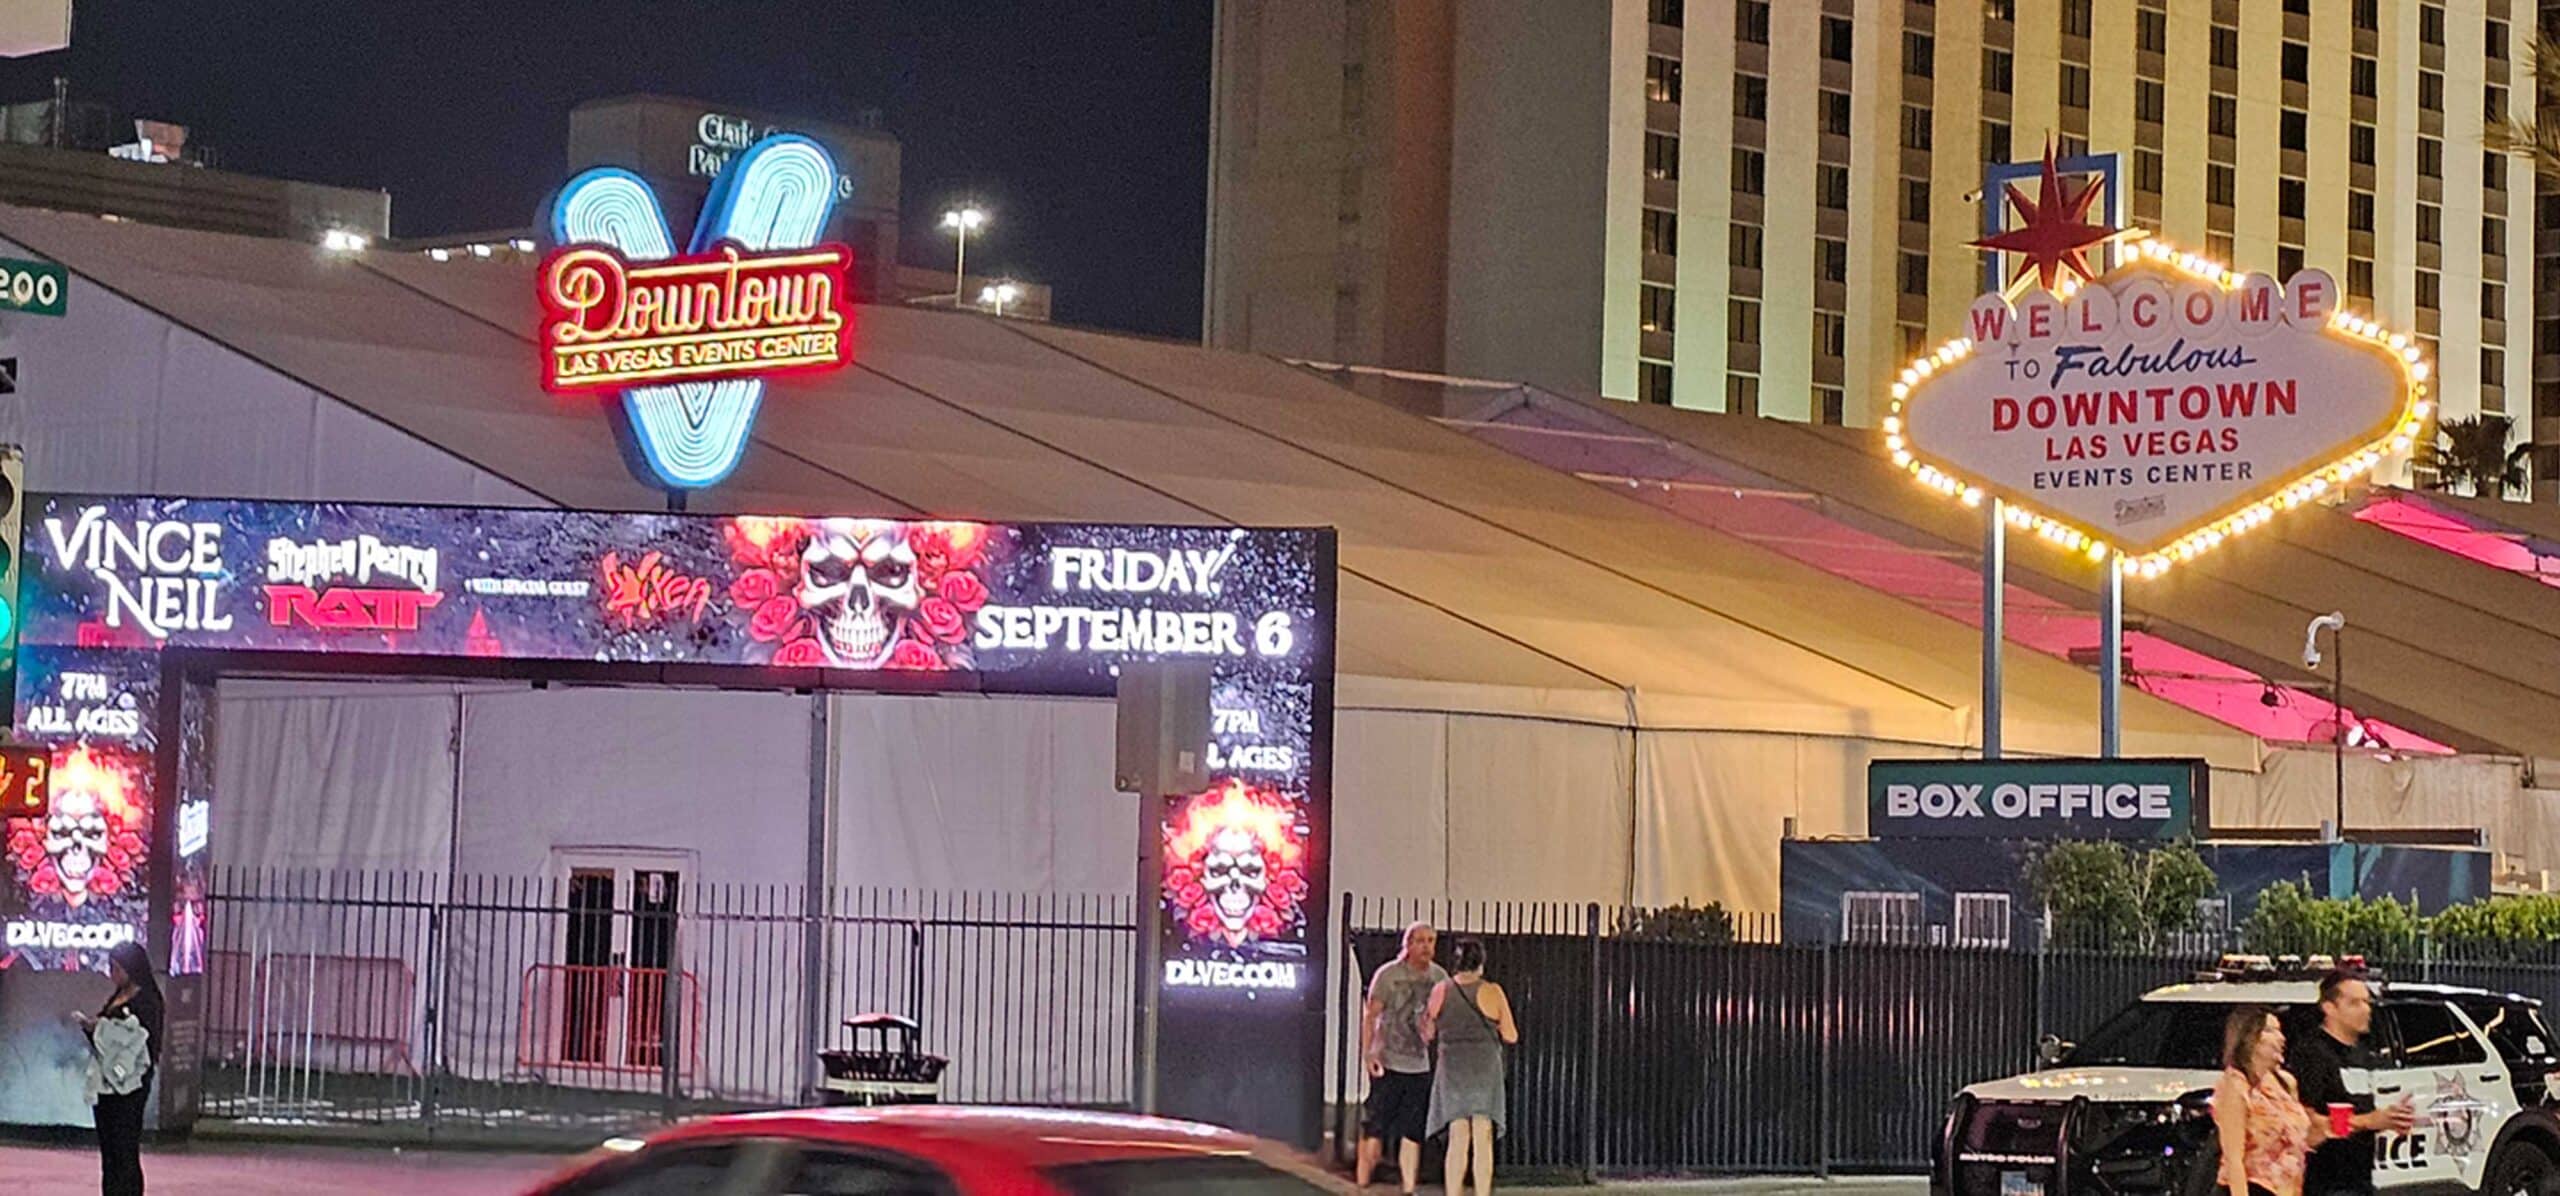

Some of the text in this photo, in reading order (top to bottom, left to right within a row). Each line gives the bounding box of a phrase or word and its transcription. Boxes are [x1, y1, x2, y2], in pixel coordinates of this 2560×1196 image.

[551, 246, 842, 343] Downtown
[1970, 282, 2323, 342] WELCOME
[557, 333, 838, 377] LAS VEGAS EVENTS CENTER
[2005, 338, 2257, 390] TO Fabulous
[1992, 379, 2297, 432] DOWNTOWN
[2046, 428, 2239, 462] LAS VEGAS
[2033, 462, 2253, 489] EVENTS CENTER
[44, 505, 223, 573] VINCE
[95, 568, 234, 638] NEIL
[263, 584, 445, 631] RATT
[974, 604, 1294, 656] SEPTEMBER 6
[26, 705, 139, 735] ALL AGES
[1212, 708, 1261, 734] 7PM
[1228, 744, 1293, 770] AGES
[25, 757, 45, 806] 2
[1886, 783, 2172, 819] BOX OFFICE
[2375, 1133, 2429, 1170] ICE
